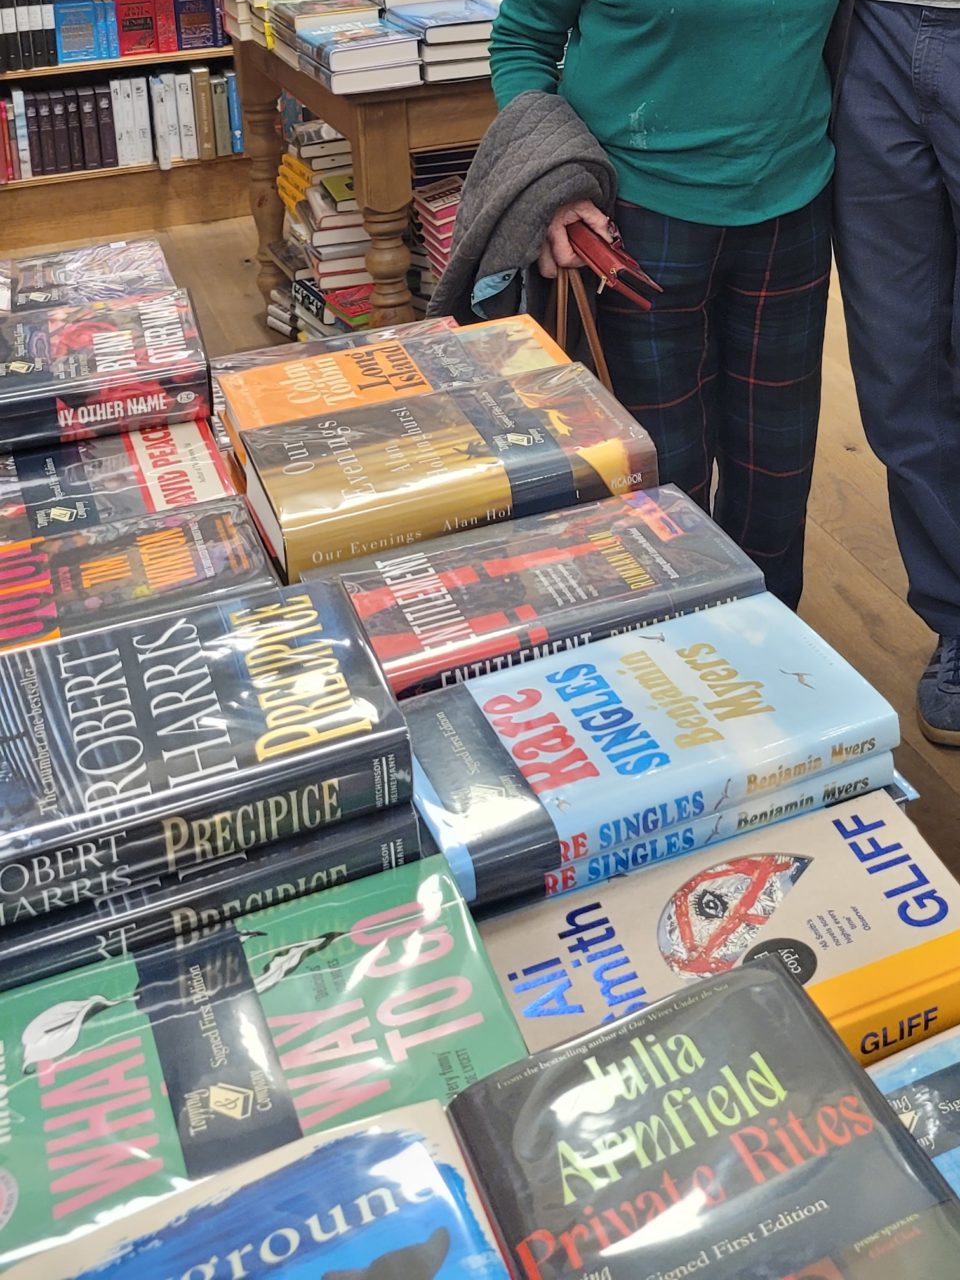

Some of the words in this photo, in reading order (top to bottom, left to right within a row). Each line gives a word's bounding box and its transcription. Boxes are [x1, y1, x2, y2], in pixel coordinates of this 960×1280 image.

[282, 361, 322, 406] Colm
[312, 355, 351, 408] Tóibín
[351, 351, 390, 393] Long
[378, 338, 425, 392] Island
[77, 400, 125, 424] OTHER
[127, 392, 167, 415] NAME
[140, 421, 184, 469] PEACE
[283, 438, 317, 477] Our
[317, 418, 377, 504] Evenings
[385, 444, 407, 473] Alan
[391, 405, 447, 478] Hollinghurst
[157, 469, 198, 508] AVID
[611, 472, 643, 488] PICADOR
[311, 545, 344, 564] Our
[350, 529, 423, 557] Evenings
[442, 512, 479, 534] Alan
[80, 553, 133, 589] TIM
[375, 551, 477, 653] ENTITLEMENT
[229, 594, 373, 762] PRECIPICE
[440, 631, 592, 688] ENTITLEMENT
[675, 642, 777, 723] Myers
[25, 666, 46, 715] bestseller
[131, 618, 239, 789] HARRIS
[618, 649, 726, 750] Benjamin
[56, 647, 152, 815] ROBERT
[482, 688, 601, 796] Rare
[545, 663, 671, 776] SINGLES
[34, 733, 54, 784] number
[373, 758, 384, 809] HUTCHINSON
[389, 753, 399, 804] HEINEMANN
[39, 783, 58, 818] The
[598, 790, 705, 849] SINGLES
[745, 754, 824, 796] Benjamin
[830, 735, 877, 765] Myers
[163, 778, 344, 874] PRECIPICE
[588, 828, 697, 882] SINGLES
[736, 792, 815, 831] Benjamin
[822, 775, 870, 803] Myers
[0, 830, 127, 896] OBERT
[832, 813, 950, 929] GLIFF
[351, 901, 455, 979] GO
[850, 905, 872, 932] Observer
[189, 964, 210, 1006] Edition
[507, 955, 586, 1019] Ali
[778, 947, 802, 974] copy
[198, 1004, 218, 1038] First
[208, 1028, 230, 1069] Signed
[376, 976, 485, 1064] TO
[496, 1073, 524, 1090] From
[523, 1064, 538, 1079] the
[538, 1043, 589, 1071] bestselling
[588, 1031, 618, 1049] author
[628, 1018, 648, 1032] Our
[647, 1007, 674, 1024] Wives
[673, 996, 700, 1011] Under
[858, 1006, 940, 1056] GLIFF
[266, 997, 391, 1131] WAY
[583, 1033, 706, 1108] Julia
[37, 1036, 165, 1221] WHAT
[184, 1087, 211, 1137] Topping
[557, 1051, 789, 1206] Armfield
[516, 1165, 727, 1280] Private
[730, 1095, 876, 1185] Rites
[645, 1251, 711, 1280] Signed
[713, 1229, 756, 1262] First
[758, 1199, 830, 1238] Edition
